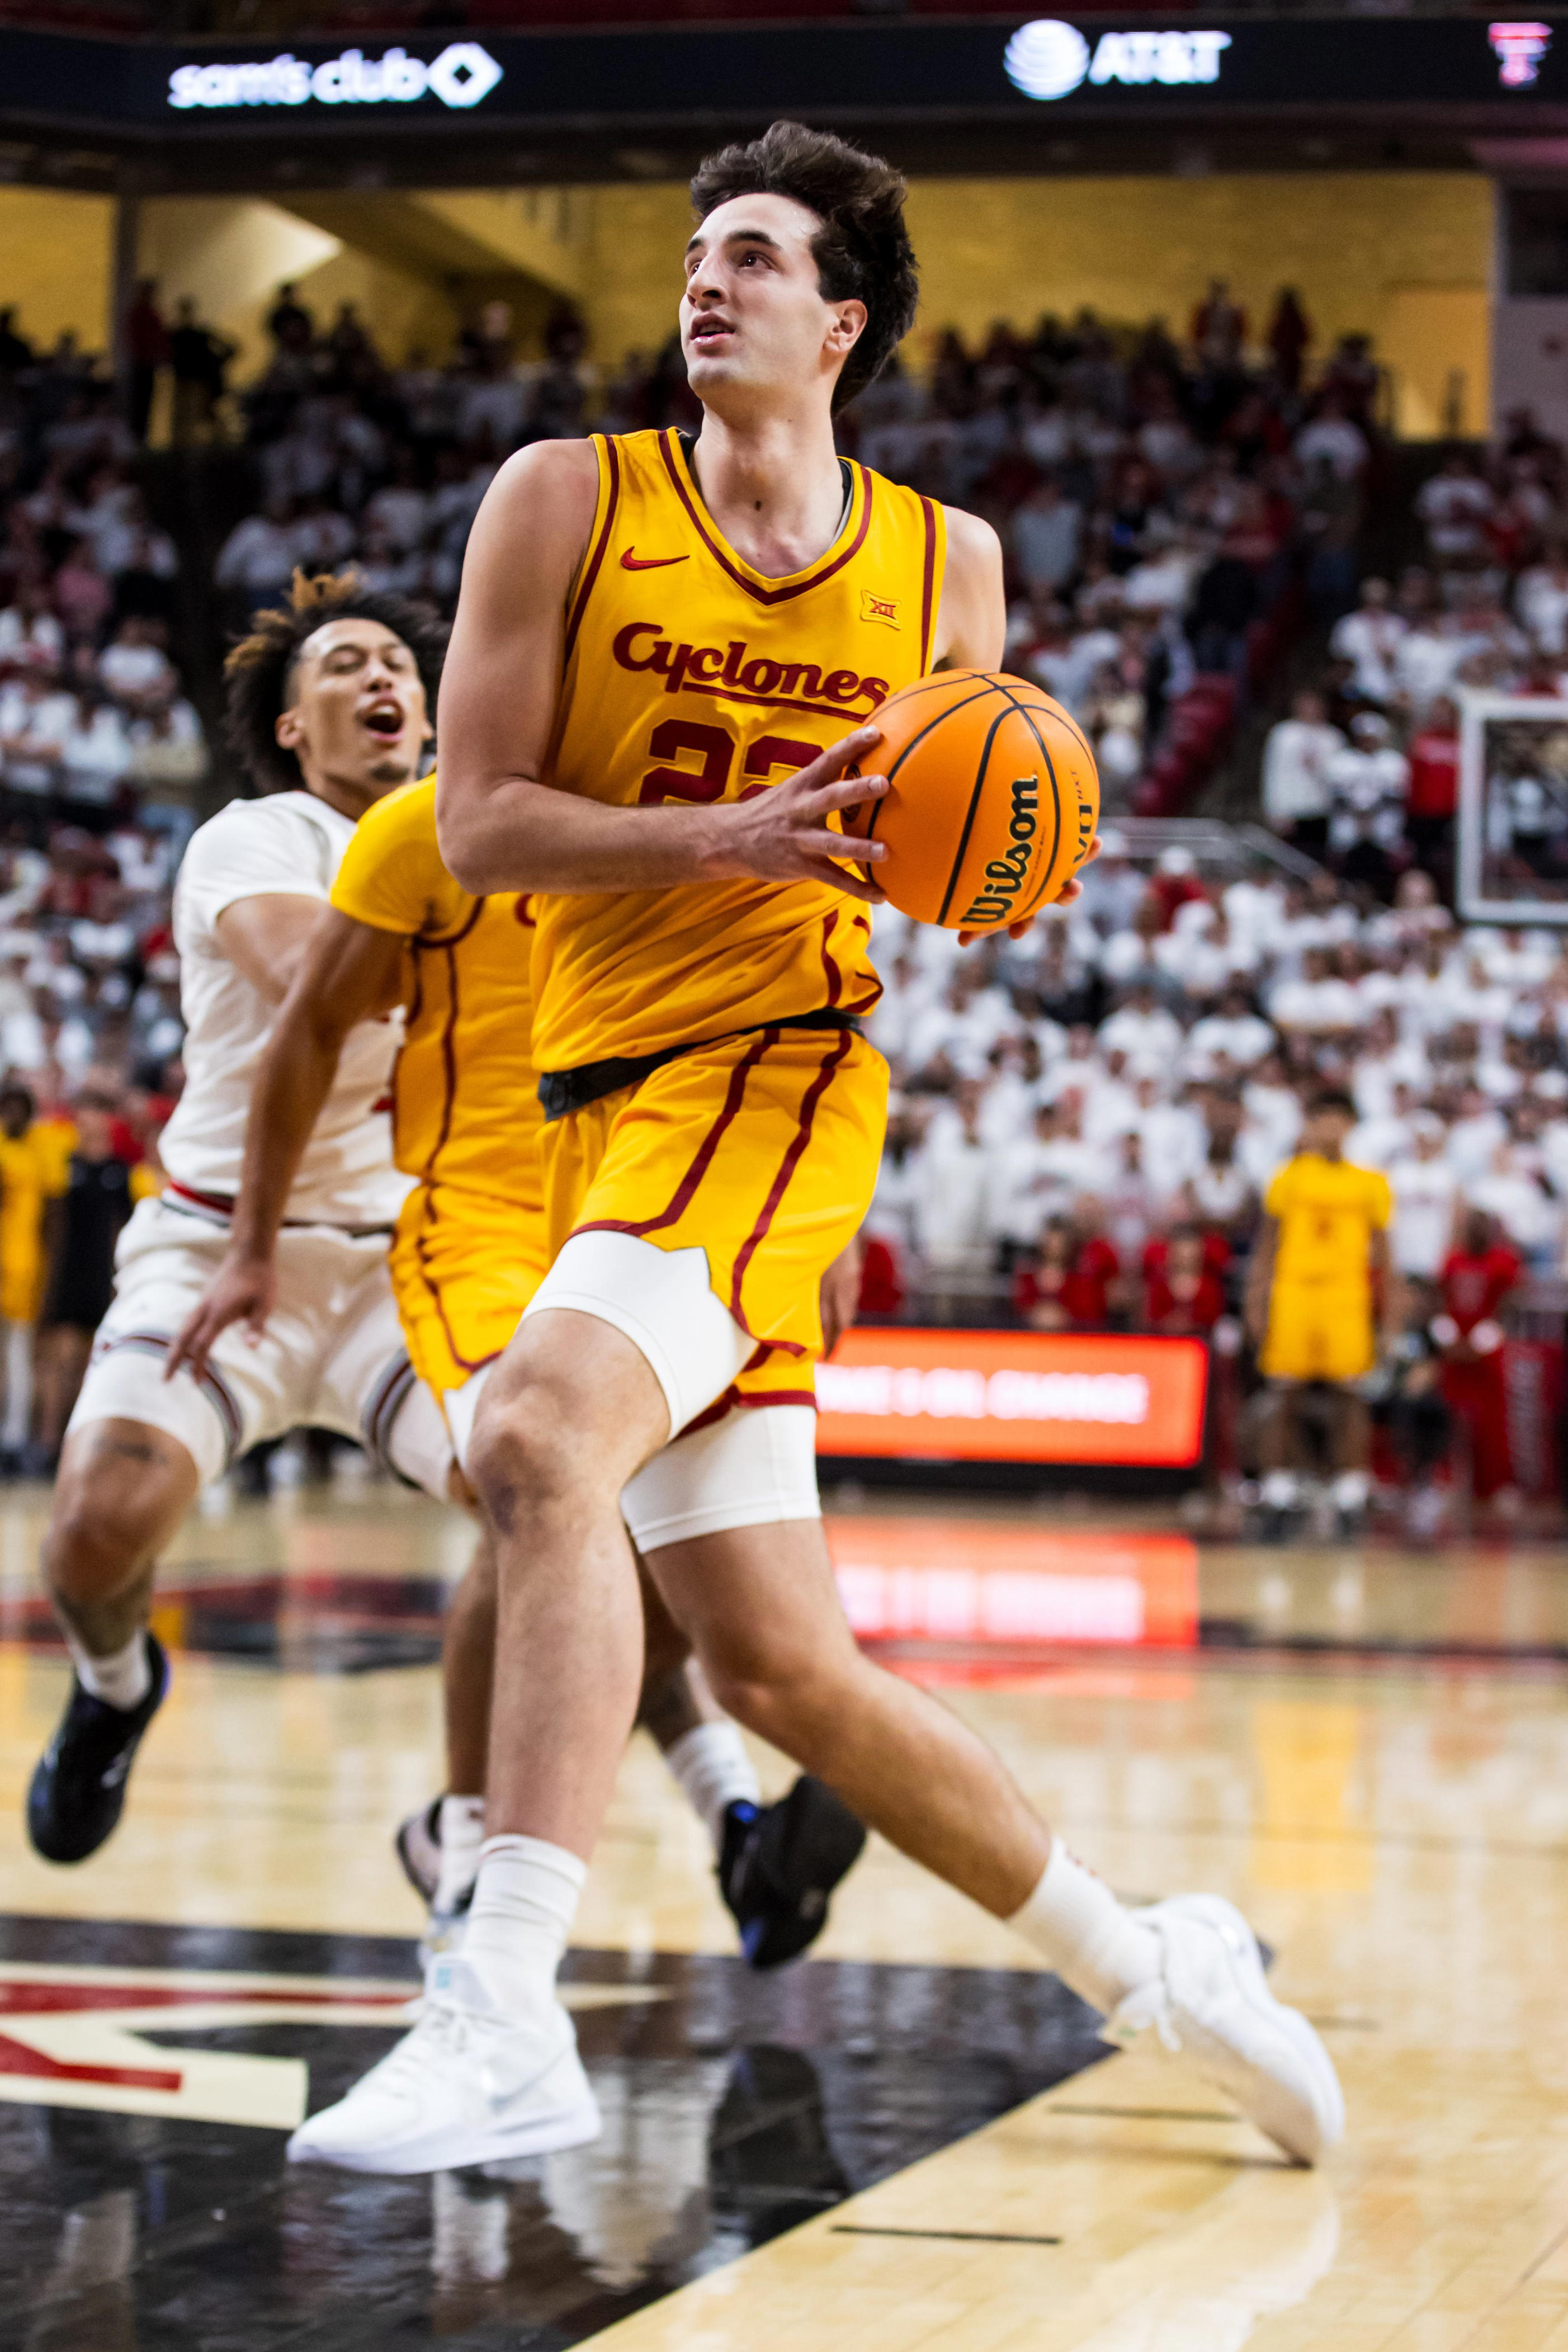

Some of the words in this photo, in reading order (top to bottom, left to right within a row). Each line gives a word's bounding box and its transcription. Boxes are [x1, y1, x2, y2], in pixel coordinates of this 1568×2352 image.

[1087, 31, 1232, 86] AT&T
[612, 622, 890, 710] Cyclones
[958, 774, 1039, 924] Wilson
